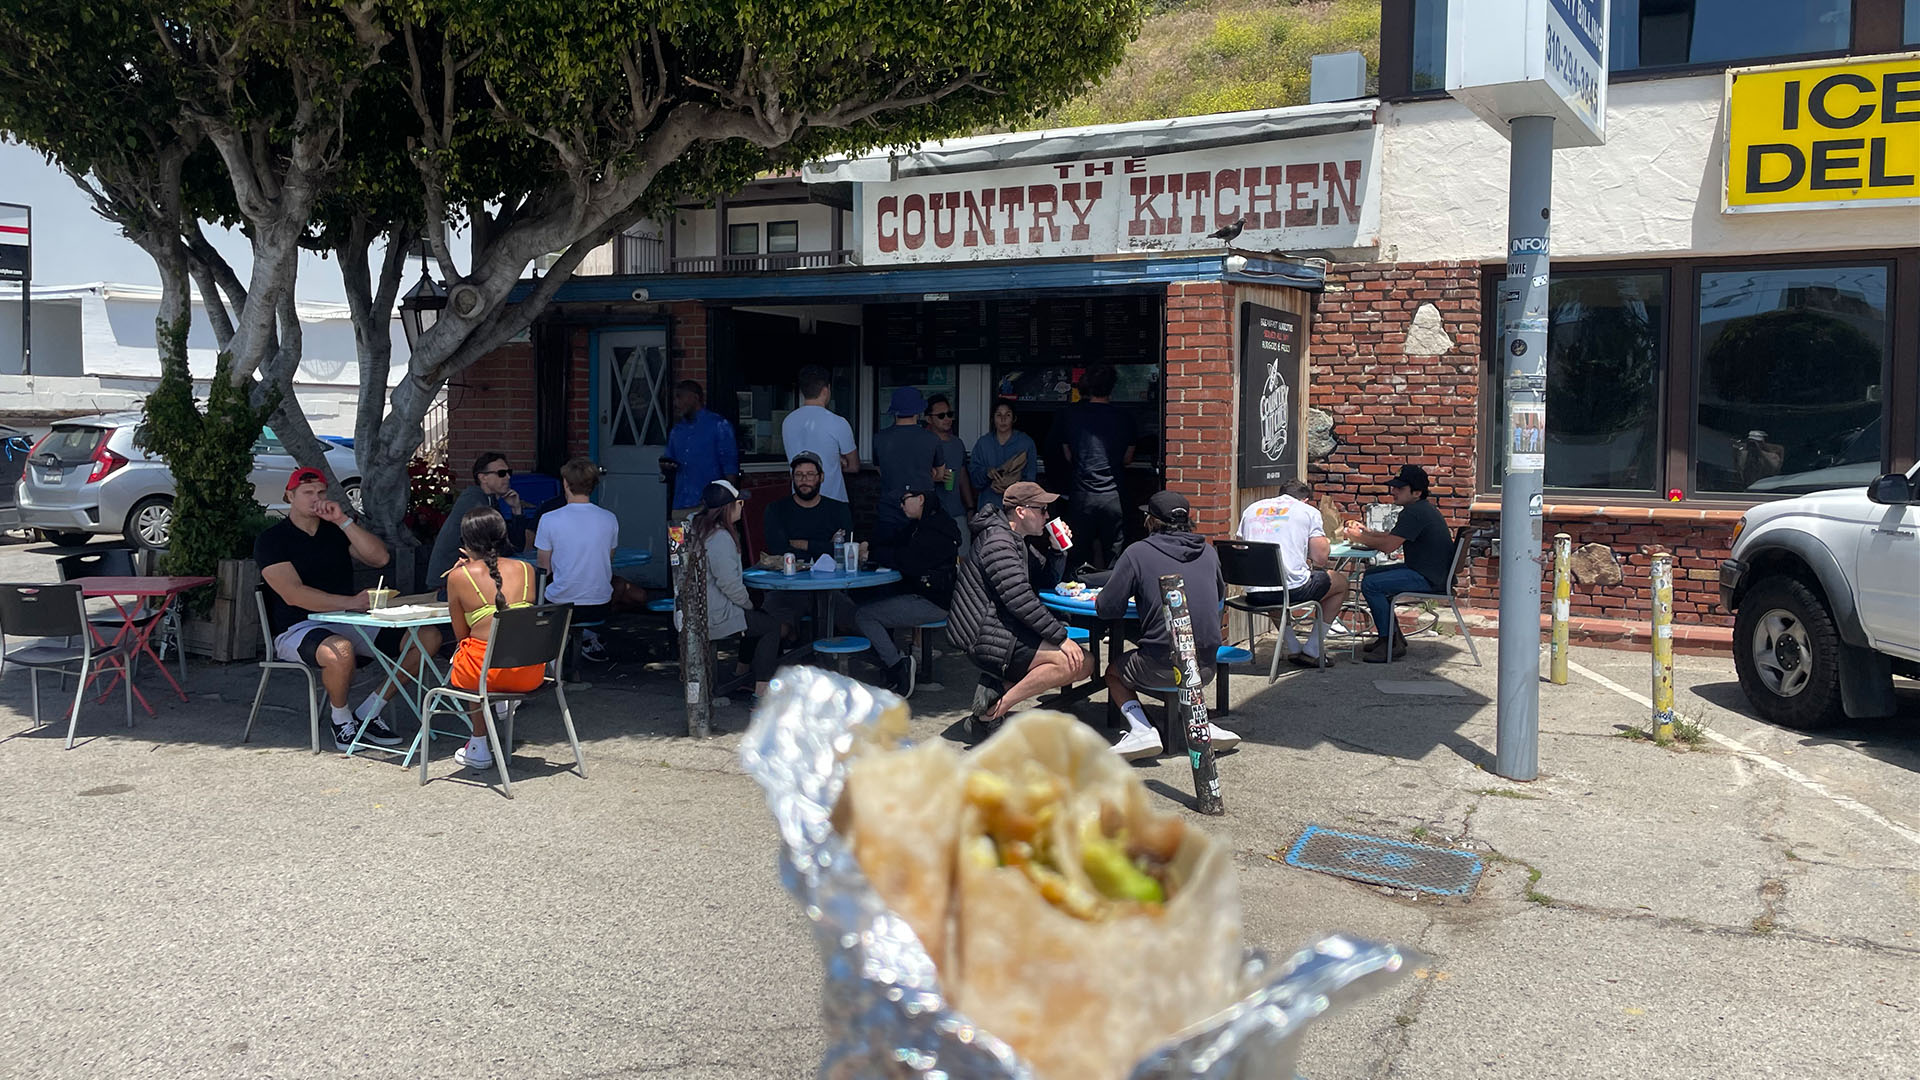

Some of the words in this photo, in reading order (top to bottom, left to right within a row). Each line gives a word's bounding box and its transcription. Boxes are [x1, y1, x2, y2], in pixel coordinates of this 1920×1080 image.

[1577, 0, 1603, 52] BILLING
[1546, 24, 1598, 114] 310-294-3845
[1783, 72, 1920, 130] ICE
[1053, 158, 1147, 179] THE
[1745, 137, 1915, 193] DEL
[877, 181, 1103, 253] COUNTRY
[1128, 160, 1362, 236] KITCHEN
